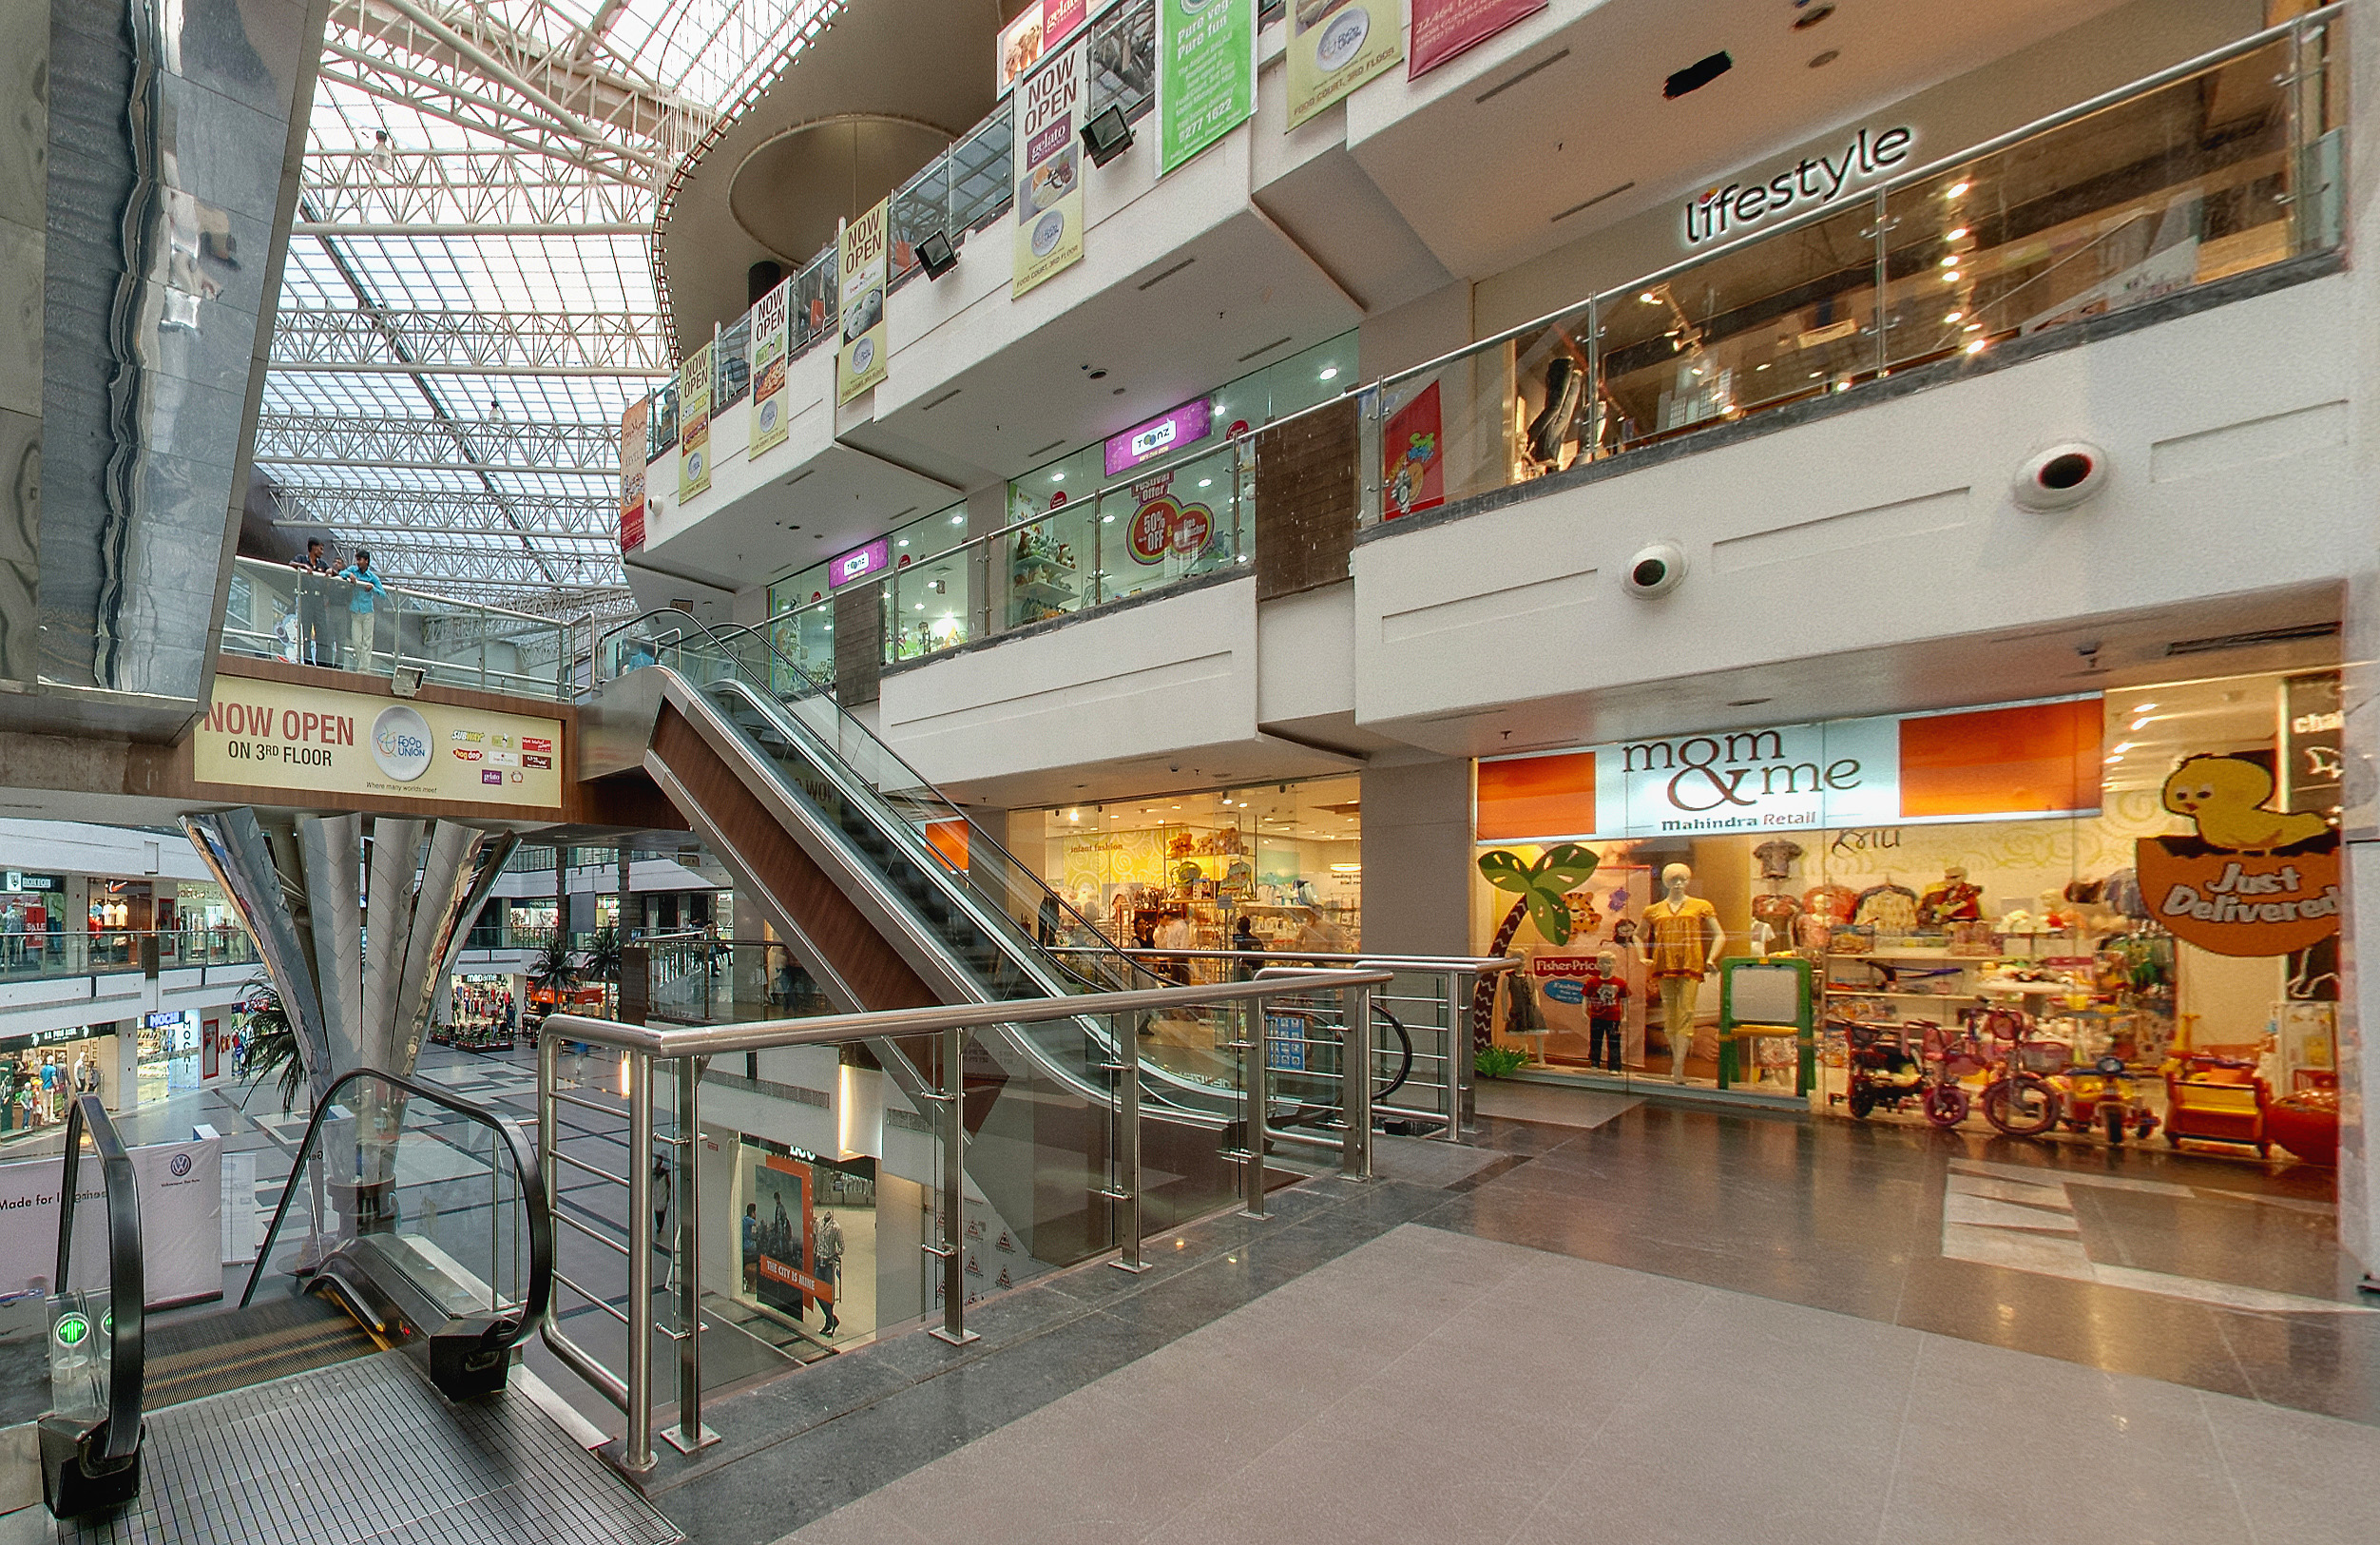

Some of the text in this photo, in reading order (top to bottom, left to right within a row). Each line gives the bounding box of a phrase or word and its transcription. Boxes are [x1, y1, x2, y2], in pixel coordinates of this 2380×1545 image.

[1178, 16, 1204, 44] Pure
[1178, 14, 1227, 61] Pure fun
[1027, 49, 1077, 109] NOW
[1025, 76, 1077, 136] OPEN
[1685, 126, 1910, 243] lifestyle
[847, 208, 880, 252] NOW
[846, 234, 882, 274] OPEN
[758, 285, 784, 322] NOW
[756, 307, 785, 341] OPEN
[685, 351, 707, 379] NOW
[684, 371, 708, 398] OPEN
[1142, 485, 1164, 501] Offer
[1143, 510, 1165, 534] 50%
[1147, 530, 1163, 551] OFF
[204, 702, 354, 746] NOW OPEN
[451, 729, 485, 743] SUBWAY
[228, 741, 332, 767] ON 3RD FLOOR
[397, 735, 422, 748] FOOD
[397, 746, 426, 757] UNION
[1622, 730, 1786, 772] mom
[1761, 759, 1861, 795] me
[1662, 811, 1816, 832] Mahindra Retail
[2205, 862, 2301, 897] Just
[2162, 885, 2340, 925] Delivered
[27, 922, 46, 932] SALE
[150, 1011, 179, 1027] MOCHI
[0, 1197, 31, 1210] Made
[36, 1194, 53, 1206] for
[766, 1260, 815, 1290] THE CITY IS MINE
